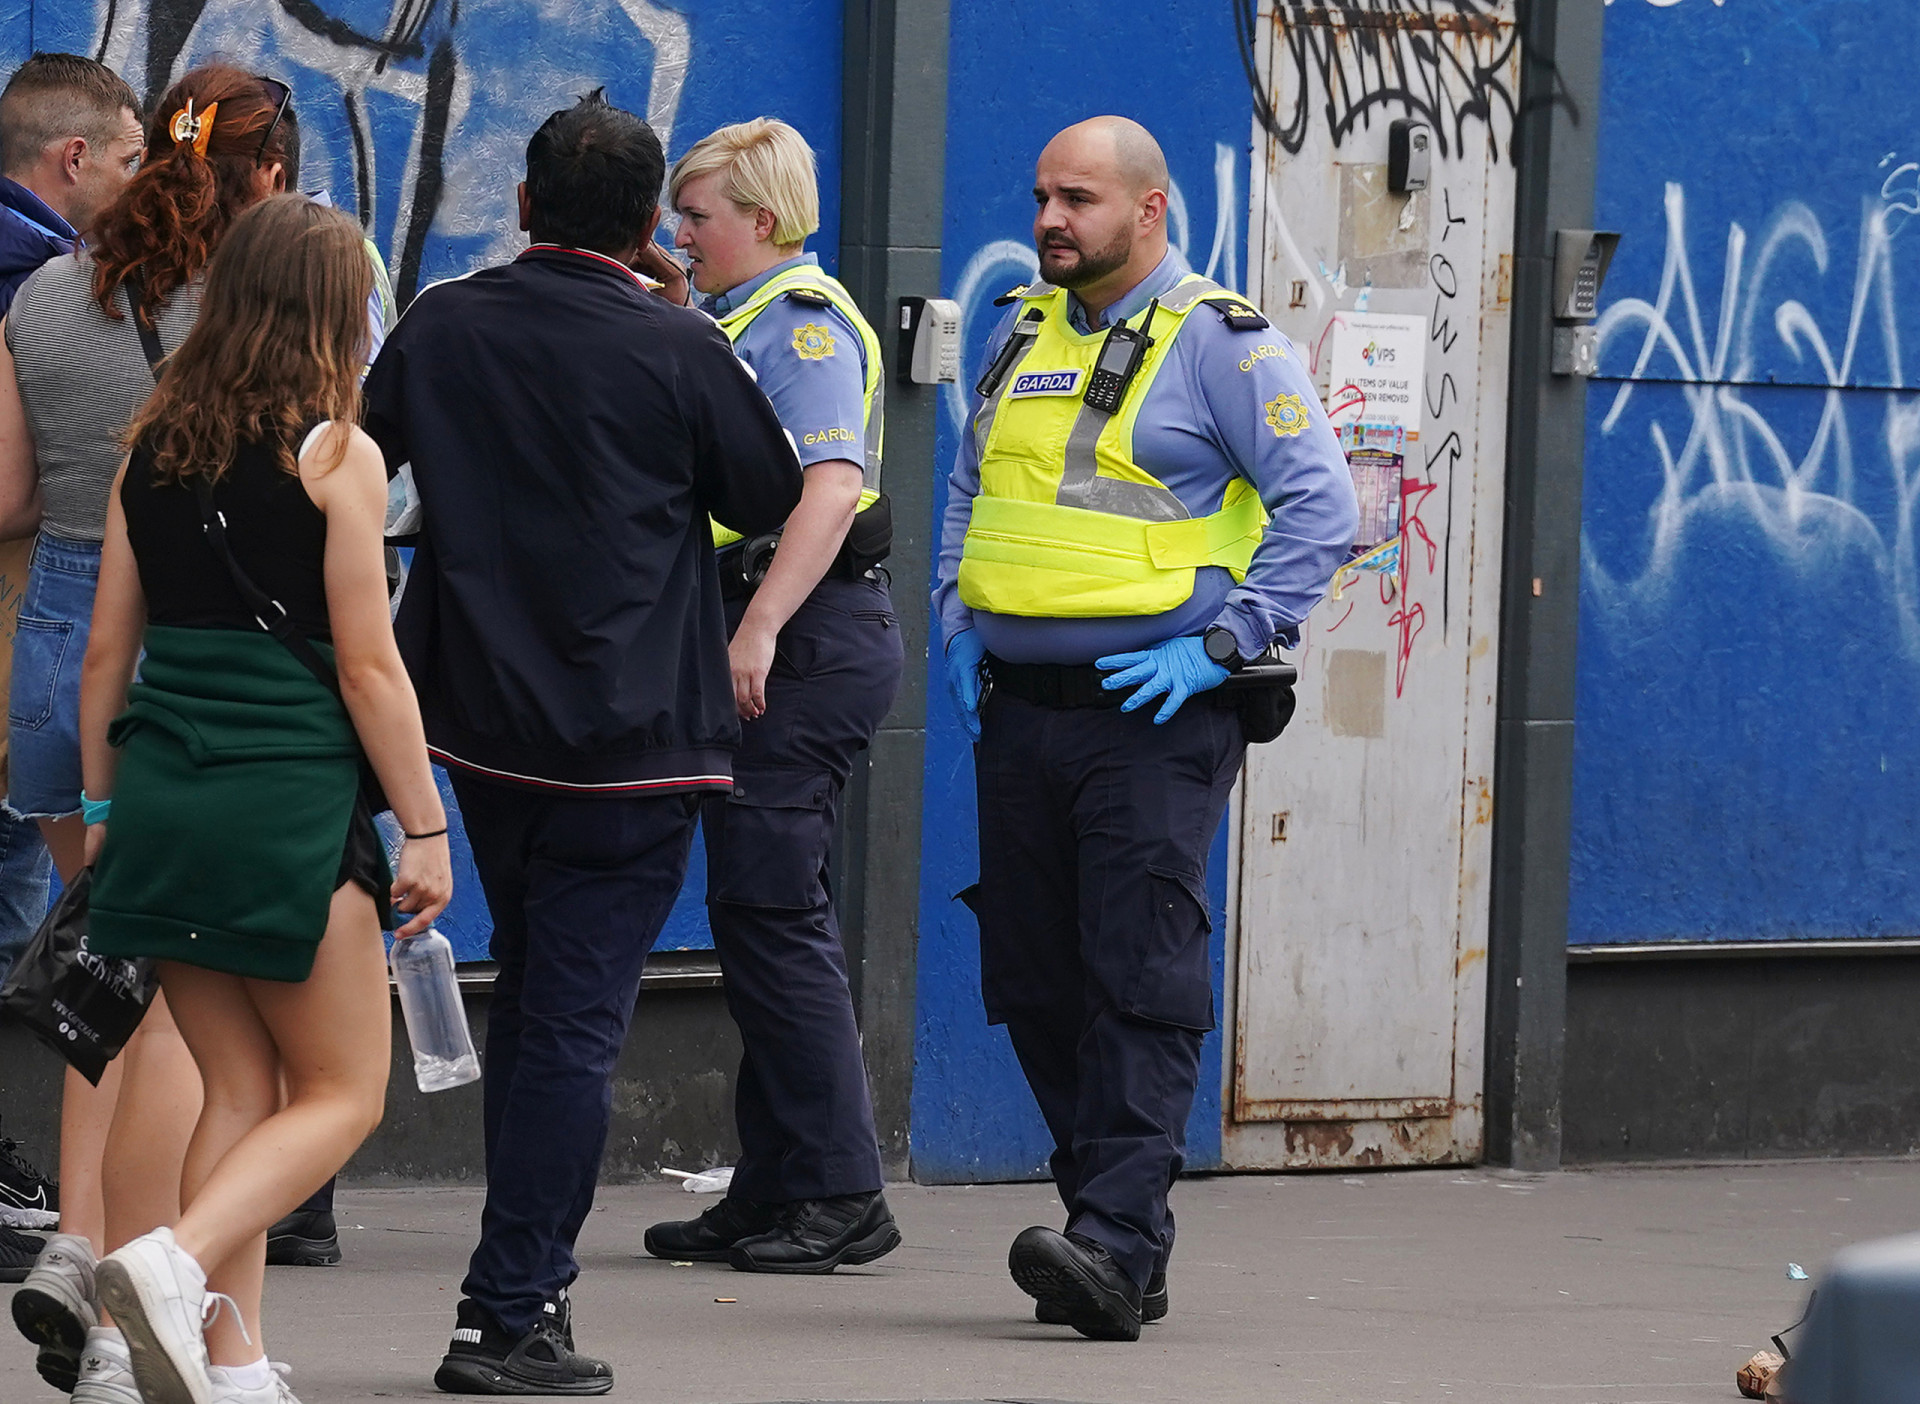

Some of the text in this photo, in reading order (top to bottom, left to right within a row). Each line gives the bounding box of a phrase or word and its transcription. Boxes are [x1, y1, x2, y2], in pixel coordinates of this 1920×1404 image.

[1239, 344, 1288, 373] GARDA
[1376, 348, 1396, 362] VPS
[1016, 374, 1072, 392] GARDA
[1357, 378, 1377, 389] ITEMS
[1389, 380, 1409, 391] VALUE
[1379, 393, 1410, 404] REMOVED
[803, 428, 857, 446] GARDA
